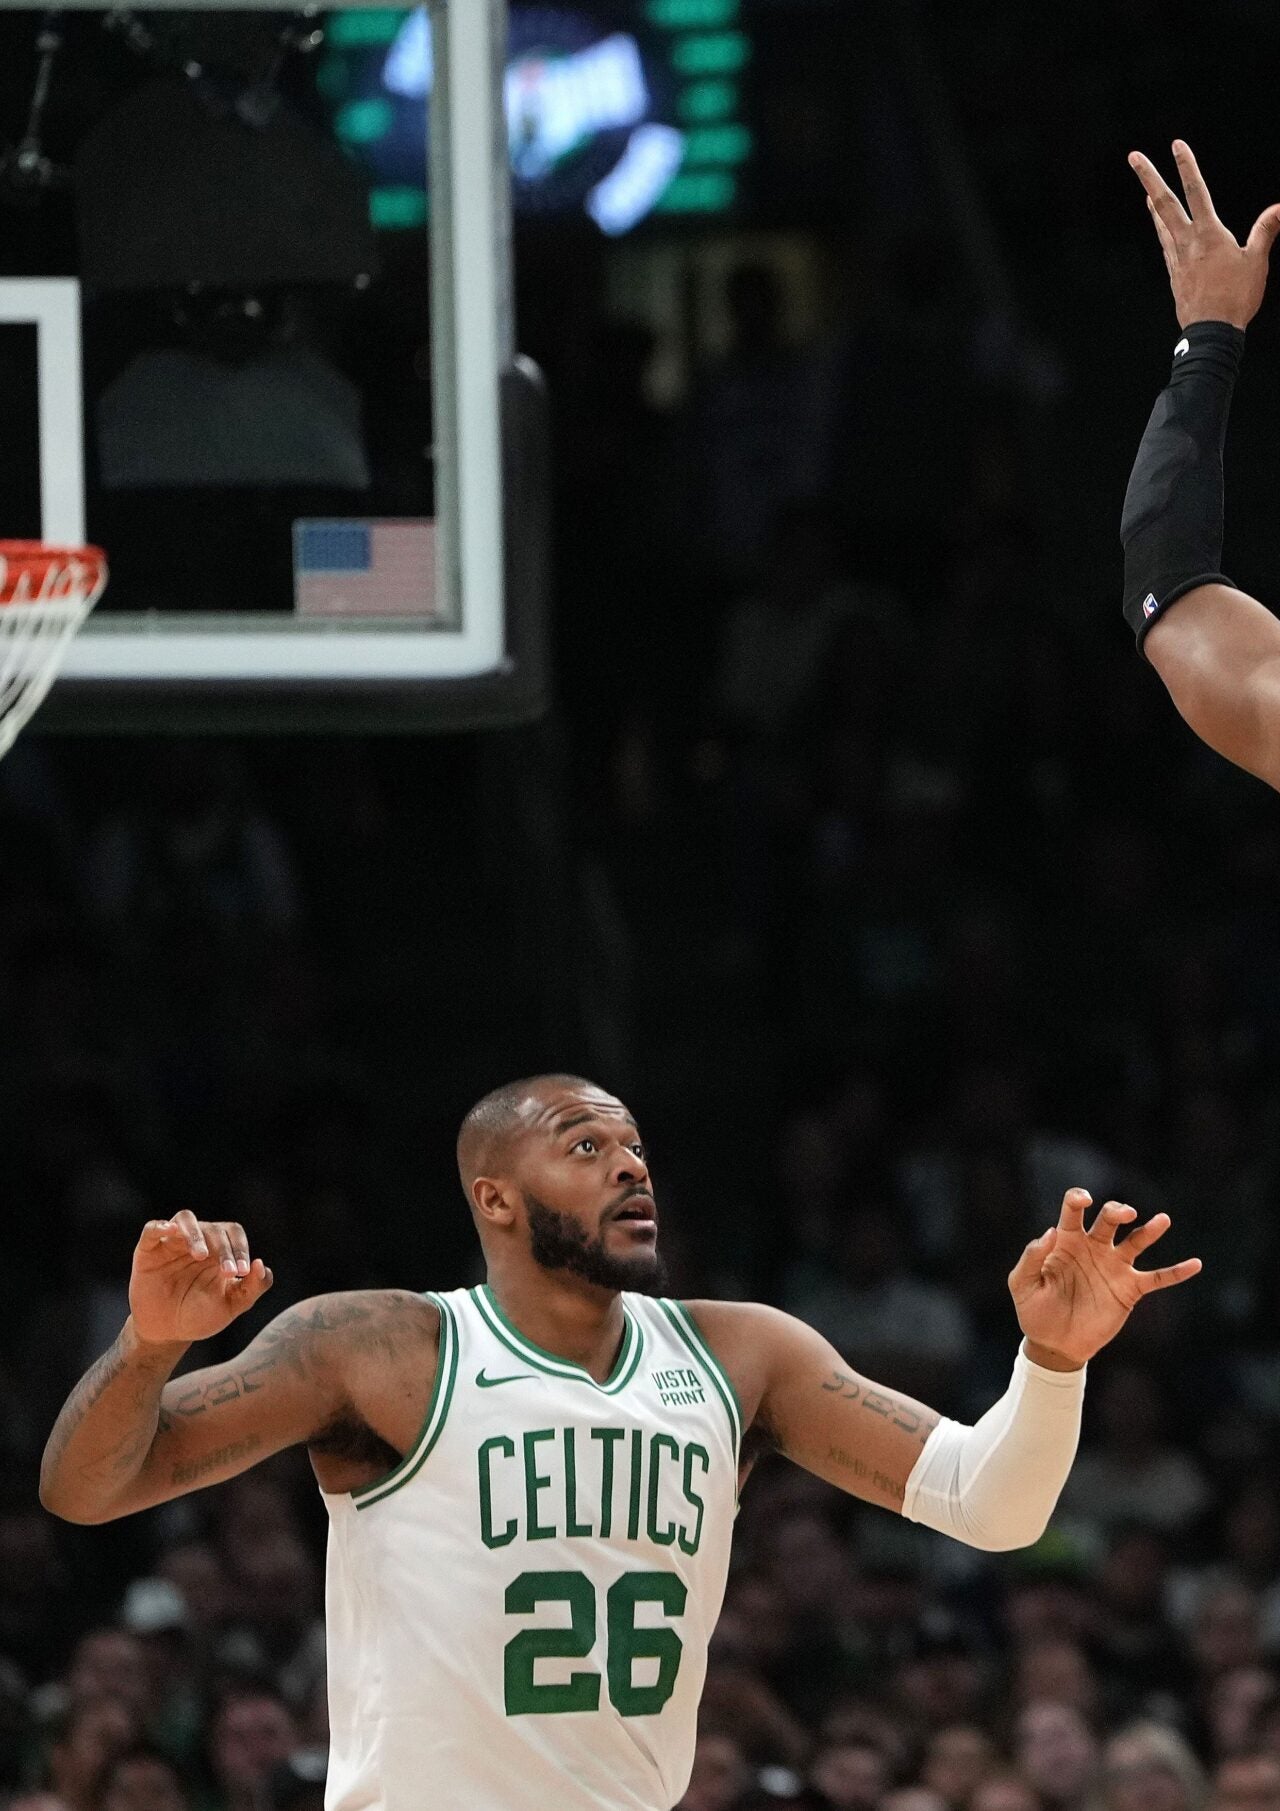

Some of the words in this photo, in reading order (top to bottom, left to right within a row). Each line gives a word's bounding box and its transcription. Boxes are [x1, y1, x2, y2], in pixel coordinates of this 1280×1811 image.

[651, 1368, 702, 1390] VISTA
[660, 1389, 709, 1407] PRINT
[477, 1427, 710, 1556] CELTICS
[504, 1570, 688, 1717] 26
